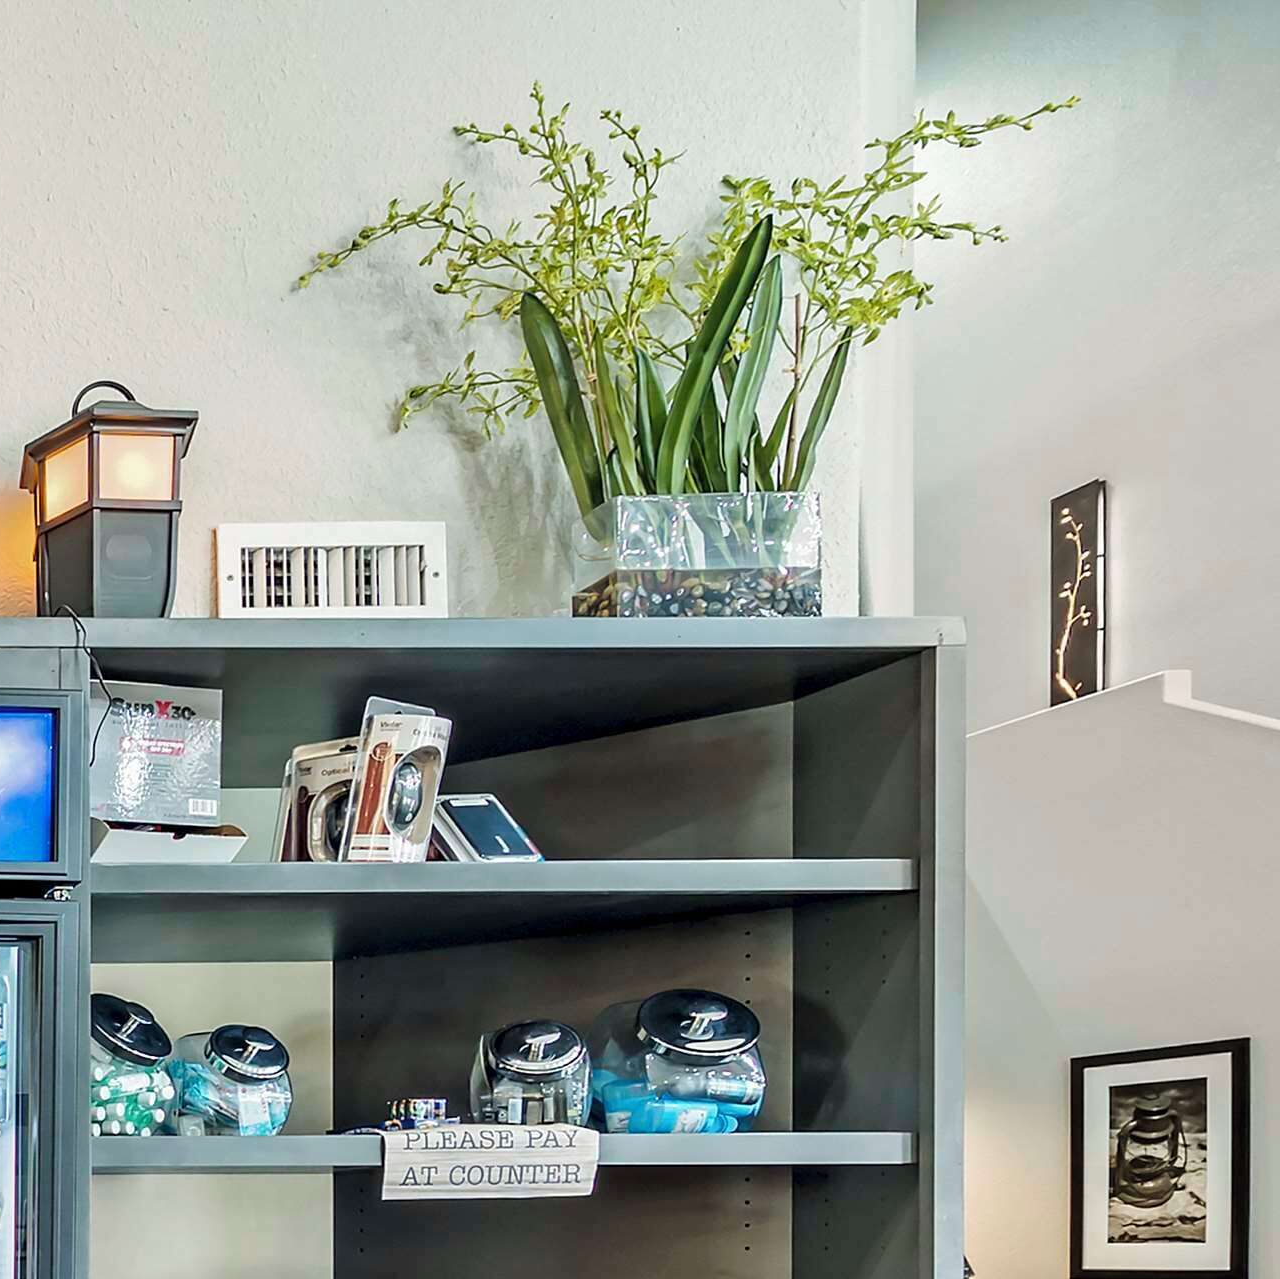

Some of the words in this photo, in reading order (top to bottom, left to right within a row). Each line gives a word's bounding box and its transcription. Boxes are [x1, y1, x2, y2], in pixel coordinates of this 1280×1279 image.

[403, 1130, 514, 1150] PLEASE
[524, 1129, 579, 1149] PAY
[399, 1166, 438, 1186] AT
[449, 1164, 581, 1186] COUNTER
